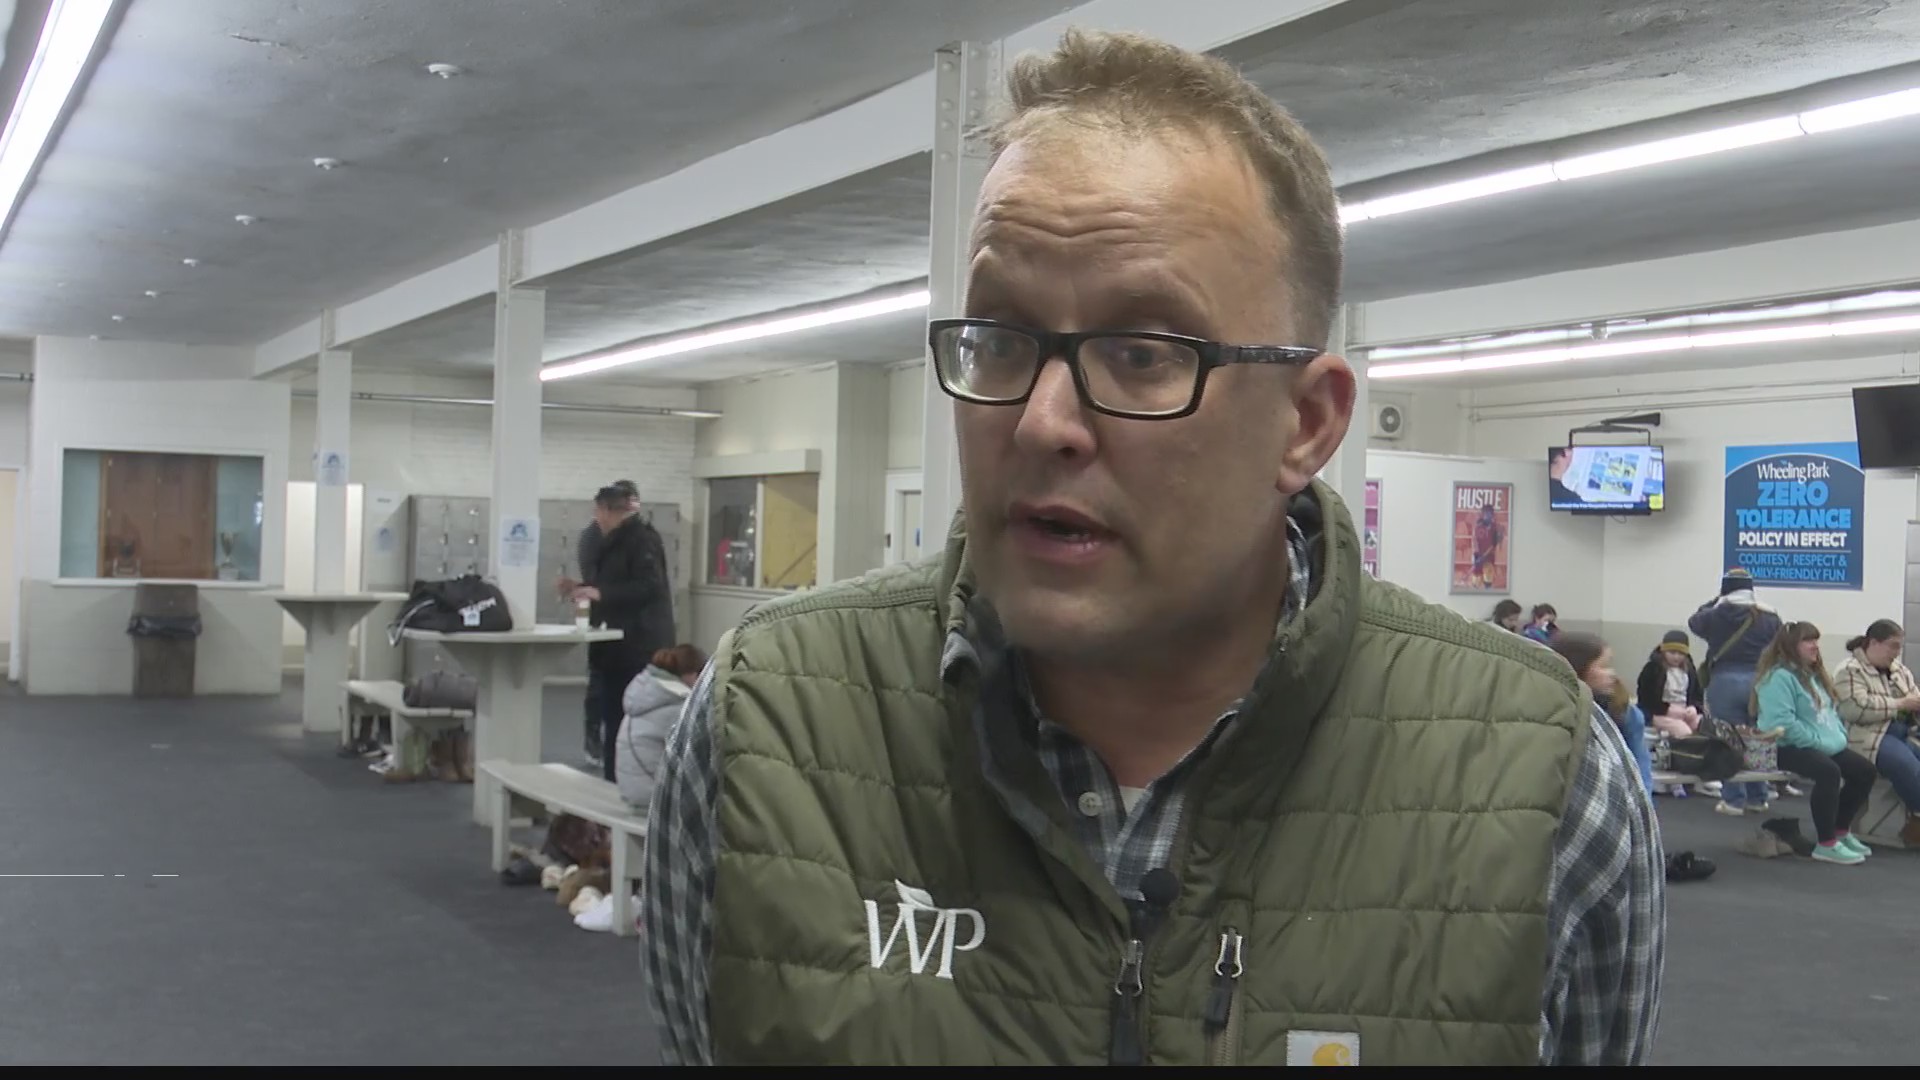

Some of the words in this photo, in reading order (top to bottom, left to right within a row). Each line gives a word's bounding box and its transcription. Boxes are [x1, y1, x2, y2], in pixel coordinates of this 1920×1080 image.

[1757, 461, 1807, 484] Wheeling
[1807, 461, 1830, 478] Park
[1457, 488, 1503, 510] HUSTLE
[1758, 481, 1829, 507] ZERO
[1736, 509, 1851, 529] TOLERANCE
[1739, 532, 1783, 546] POLICY
[1784, 532, 1799, 547] IN
[1801, 533, 1847, 547] EFFECT
[1738, 553, 1791, 566] COURTESY,
[1793, 555, 1837, 567] RESPECT
[1838, 555, 1847, 567] &
[1743, 567, 1821, 580] AMILY-FRIENDLY
[1823, 569, 1846, 581] FUN
[864, 882, 986, 979] WP
